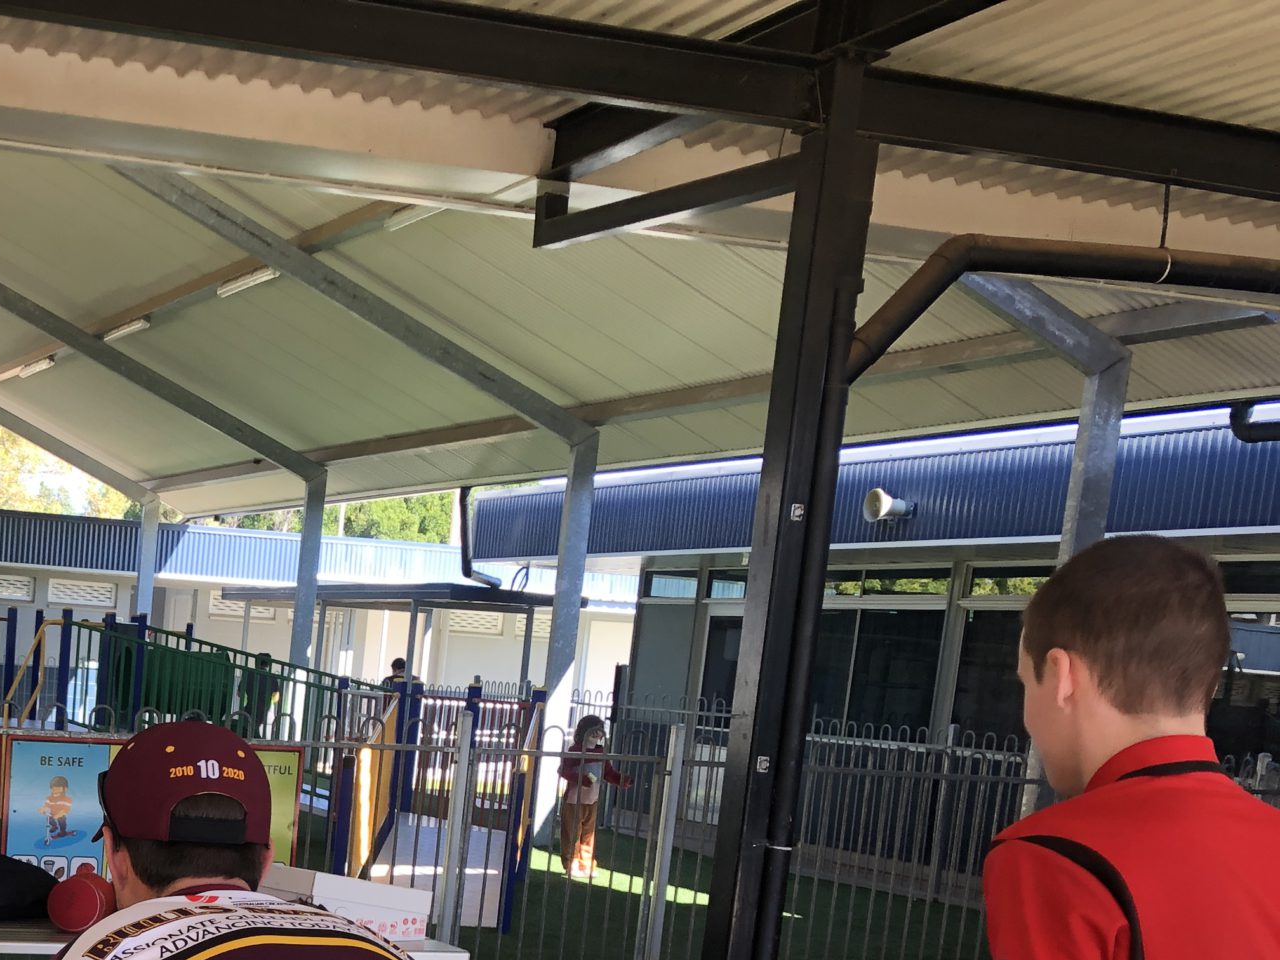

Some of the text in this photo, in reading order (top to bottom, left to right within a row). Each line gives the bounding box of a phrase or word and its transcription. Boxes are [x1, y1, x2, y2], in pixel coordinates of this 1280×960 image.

[40, 755, 84, 768] BE SAFE
[169, 759, 245, 781] 2010 10 2020
[158, 920, 283, 959] ADVANCING
